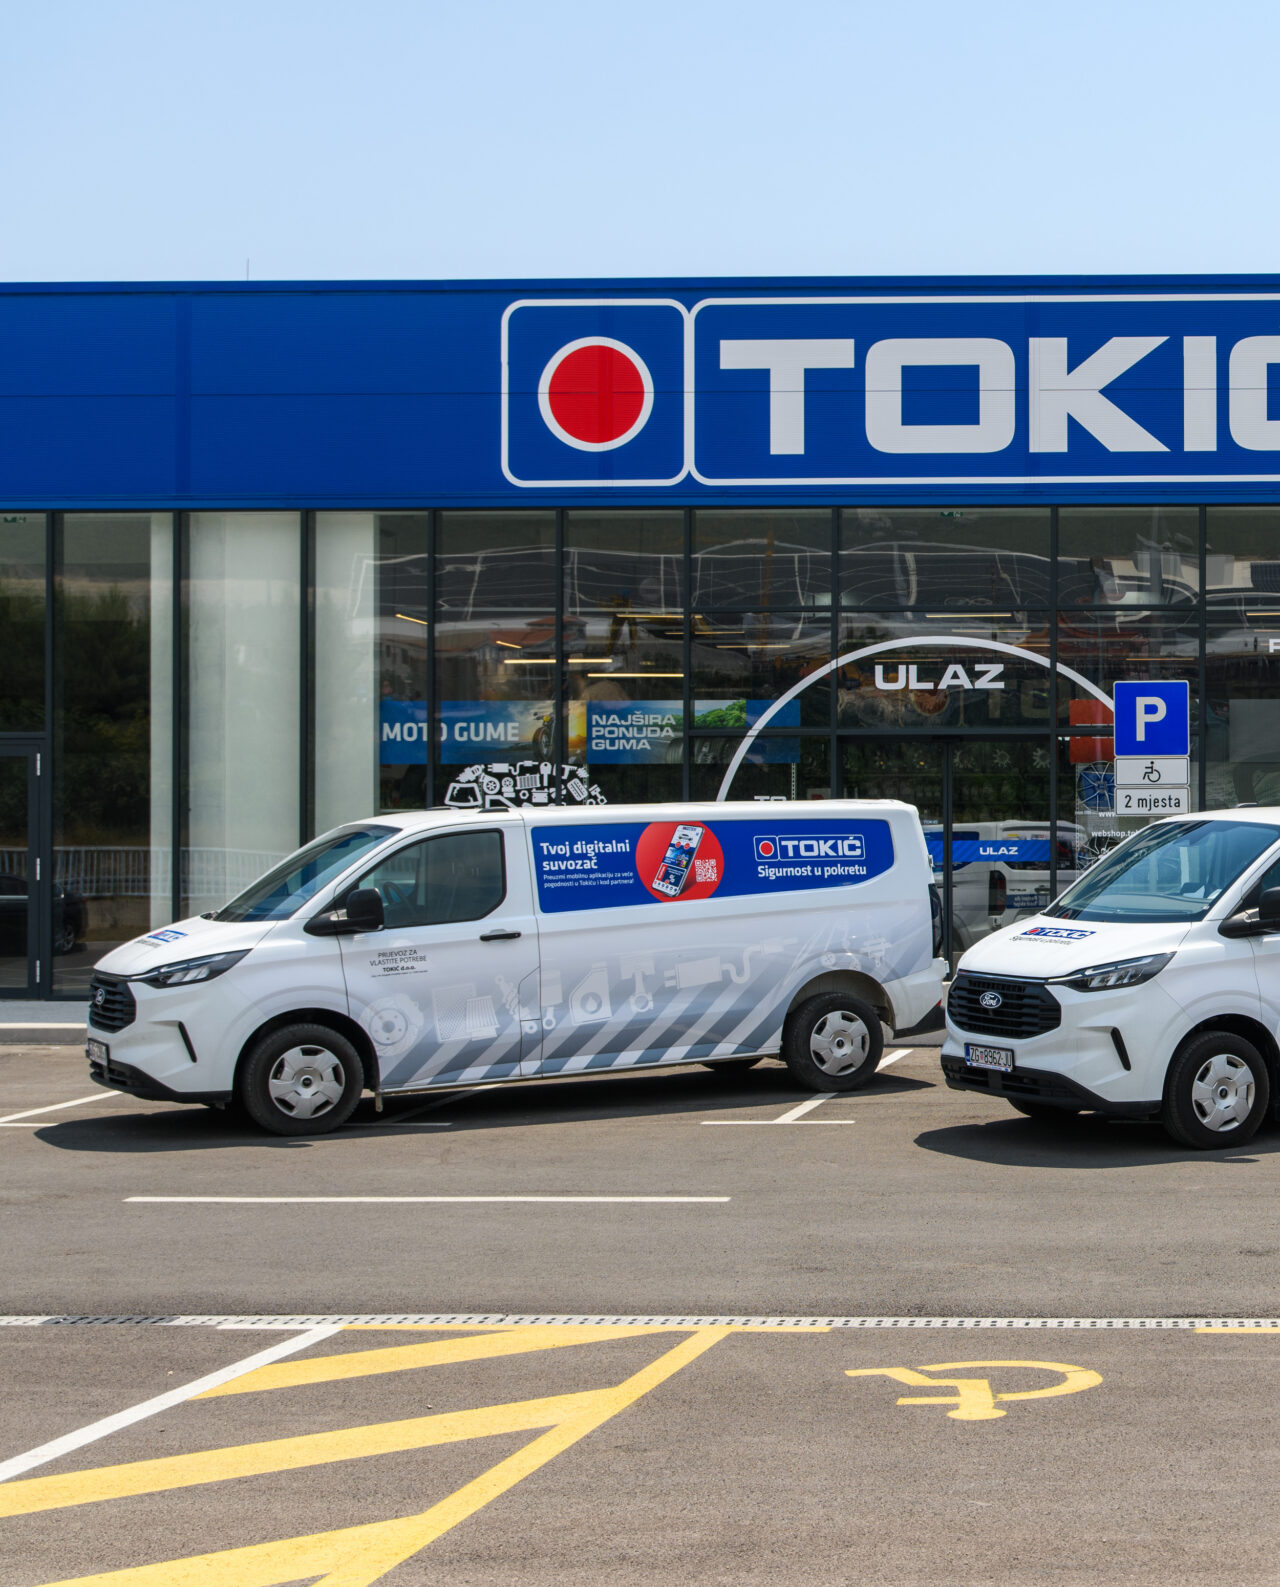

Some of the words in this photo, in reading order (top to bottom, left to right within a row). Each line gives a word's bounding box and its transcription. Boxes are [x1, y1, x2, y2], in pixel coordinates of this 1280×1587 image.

[874, 663, 1005, 690] ULAZ
[591, 710, 677, 726] NAJŠIRA
[1135, 696, 1167, 742] P
[454, 722, 520, 742] GUME
[591, 726, 675, 738] PONUDA
[591, 739, 650, 751] GUMA
[1124, 794, 1133, 809] 2
[1137, 794, 1181, 812] mjesta
[540, 842, 570, 857] Tvoj
[573, 840, 630, 857] digitalni
[781, 836, 862, 857] TOKIĆ
[979, 846, 1019, 856] ULAZ
[542, 856, 598, 871] suvozač
[757, 864, 812, 880] Sigurnost
[814, 867, 822, 876] u
[824, 863, 867, 879] pokretu
[970, 1047, 980, 1062] ZG
